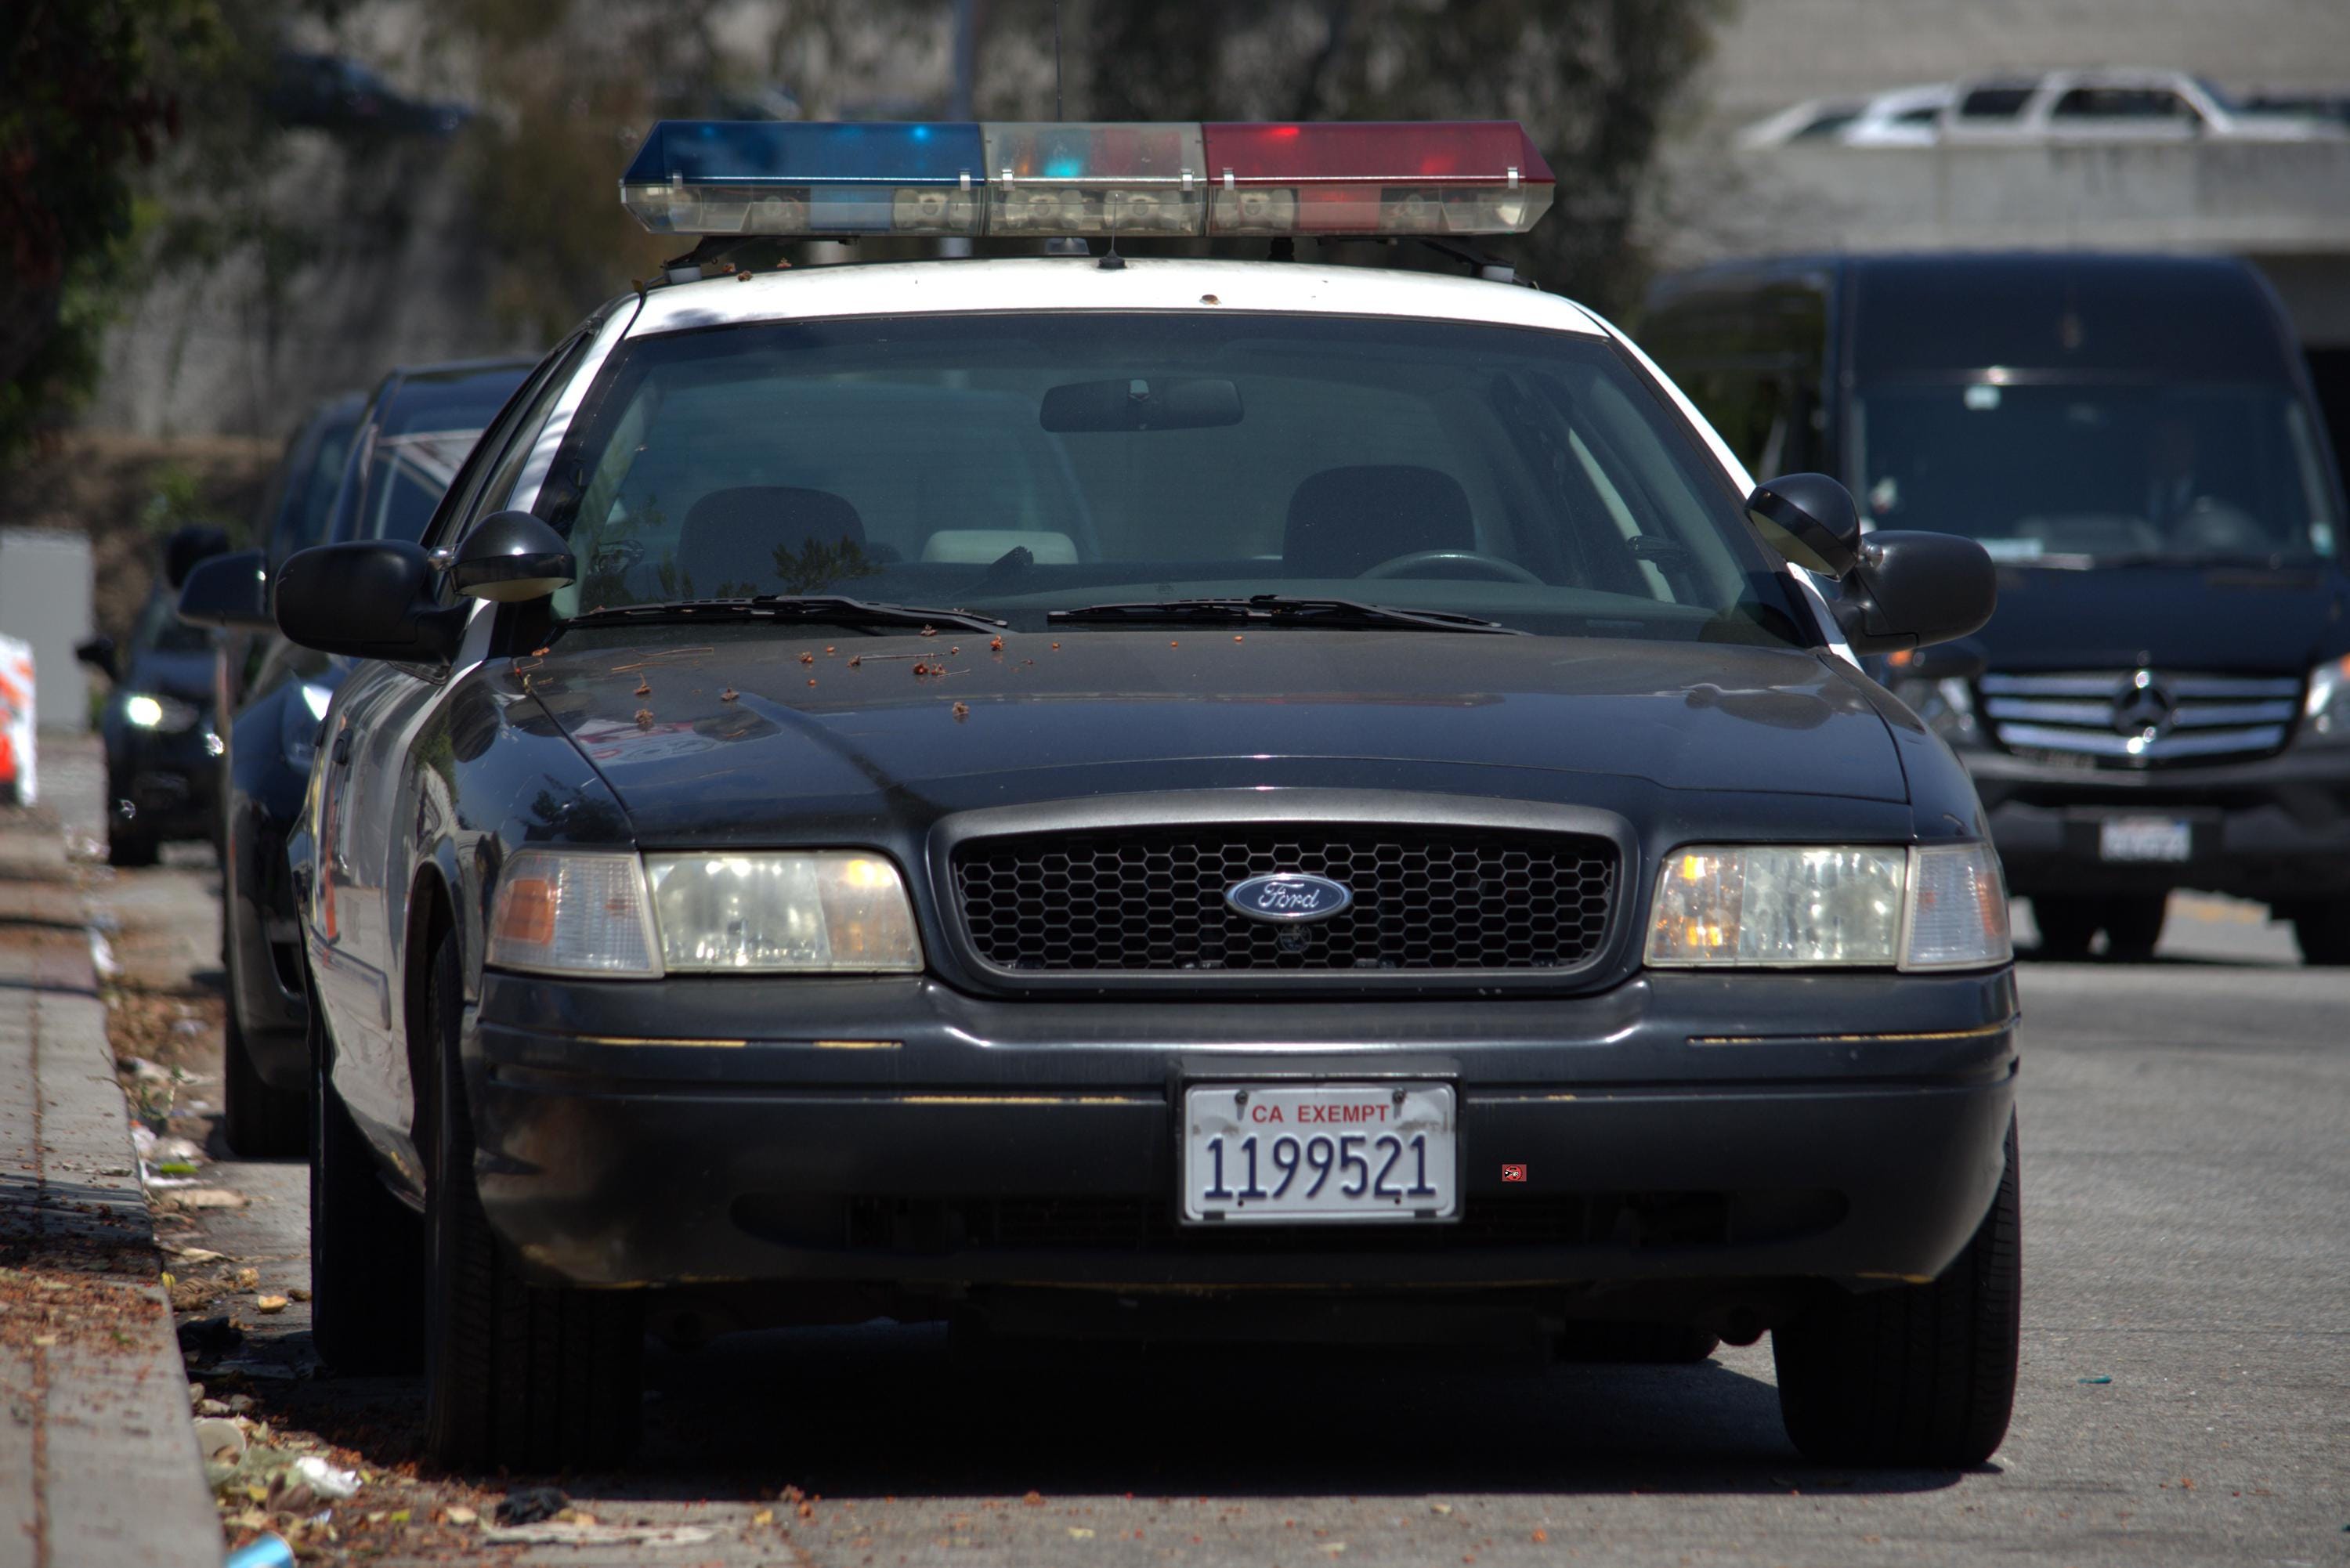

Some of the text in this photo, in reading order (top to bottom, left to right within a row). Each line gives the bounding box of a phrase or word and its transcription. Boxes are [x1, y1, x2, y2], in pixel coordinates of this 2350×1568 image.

[1258, 882, 1320, 908] Ford
[1252, 1105, 1390, 1123] CA EXEMPT
[1204, 1136, 1437, 1199] 1199521
